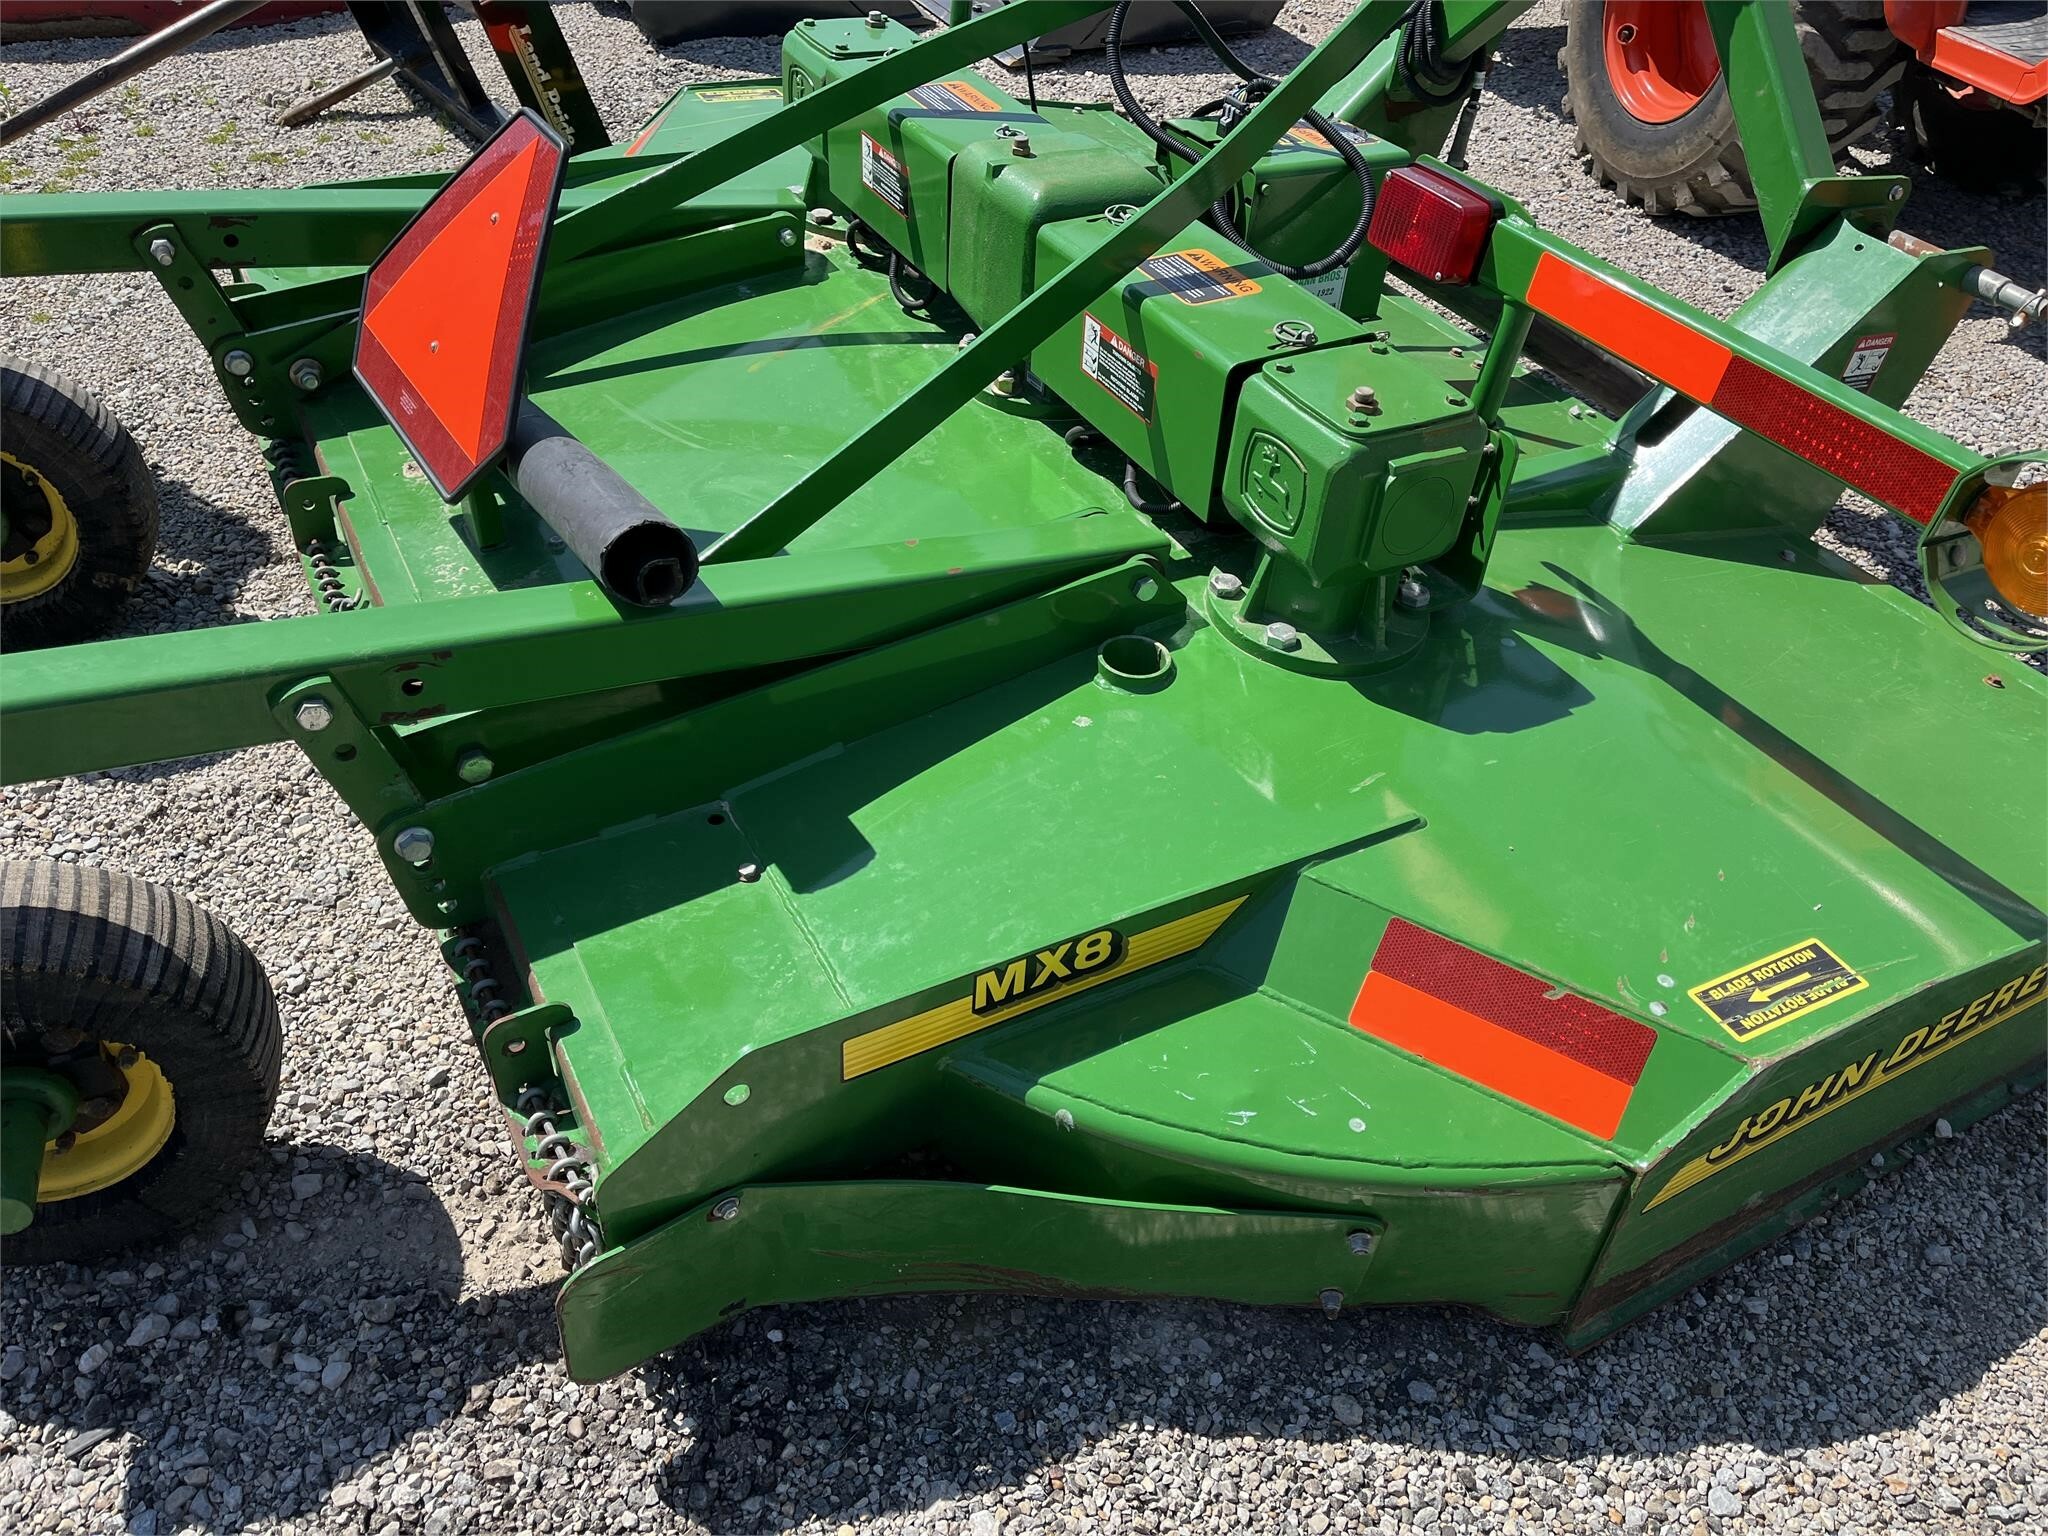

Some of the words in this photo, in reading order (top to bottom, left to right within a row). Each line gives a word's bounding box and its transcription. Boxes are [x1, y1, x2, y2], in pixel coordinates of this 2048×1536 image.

[517, 24, 552, 82] Land
[543, 87, 576, 147] Pride
[1200, 253, 1253, 293] WARNING
[1317, 288, 1335, 297] 1922
[1118, 340, 1145, 368] DANGER
[1865, 336, 1893, 347] DANGER
[974, 930, 1113, 1011] MX8
[1708, 974, 1756, 1001] BLADE
[1751, 948, 1817, 981] ROTATION
[1739, 994, 1808, 1030] ROTATION
[1707, 1052, 1878, 1160] JOHN
[1885, 963, 2048, 1069] DEERE
